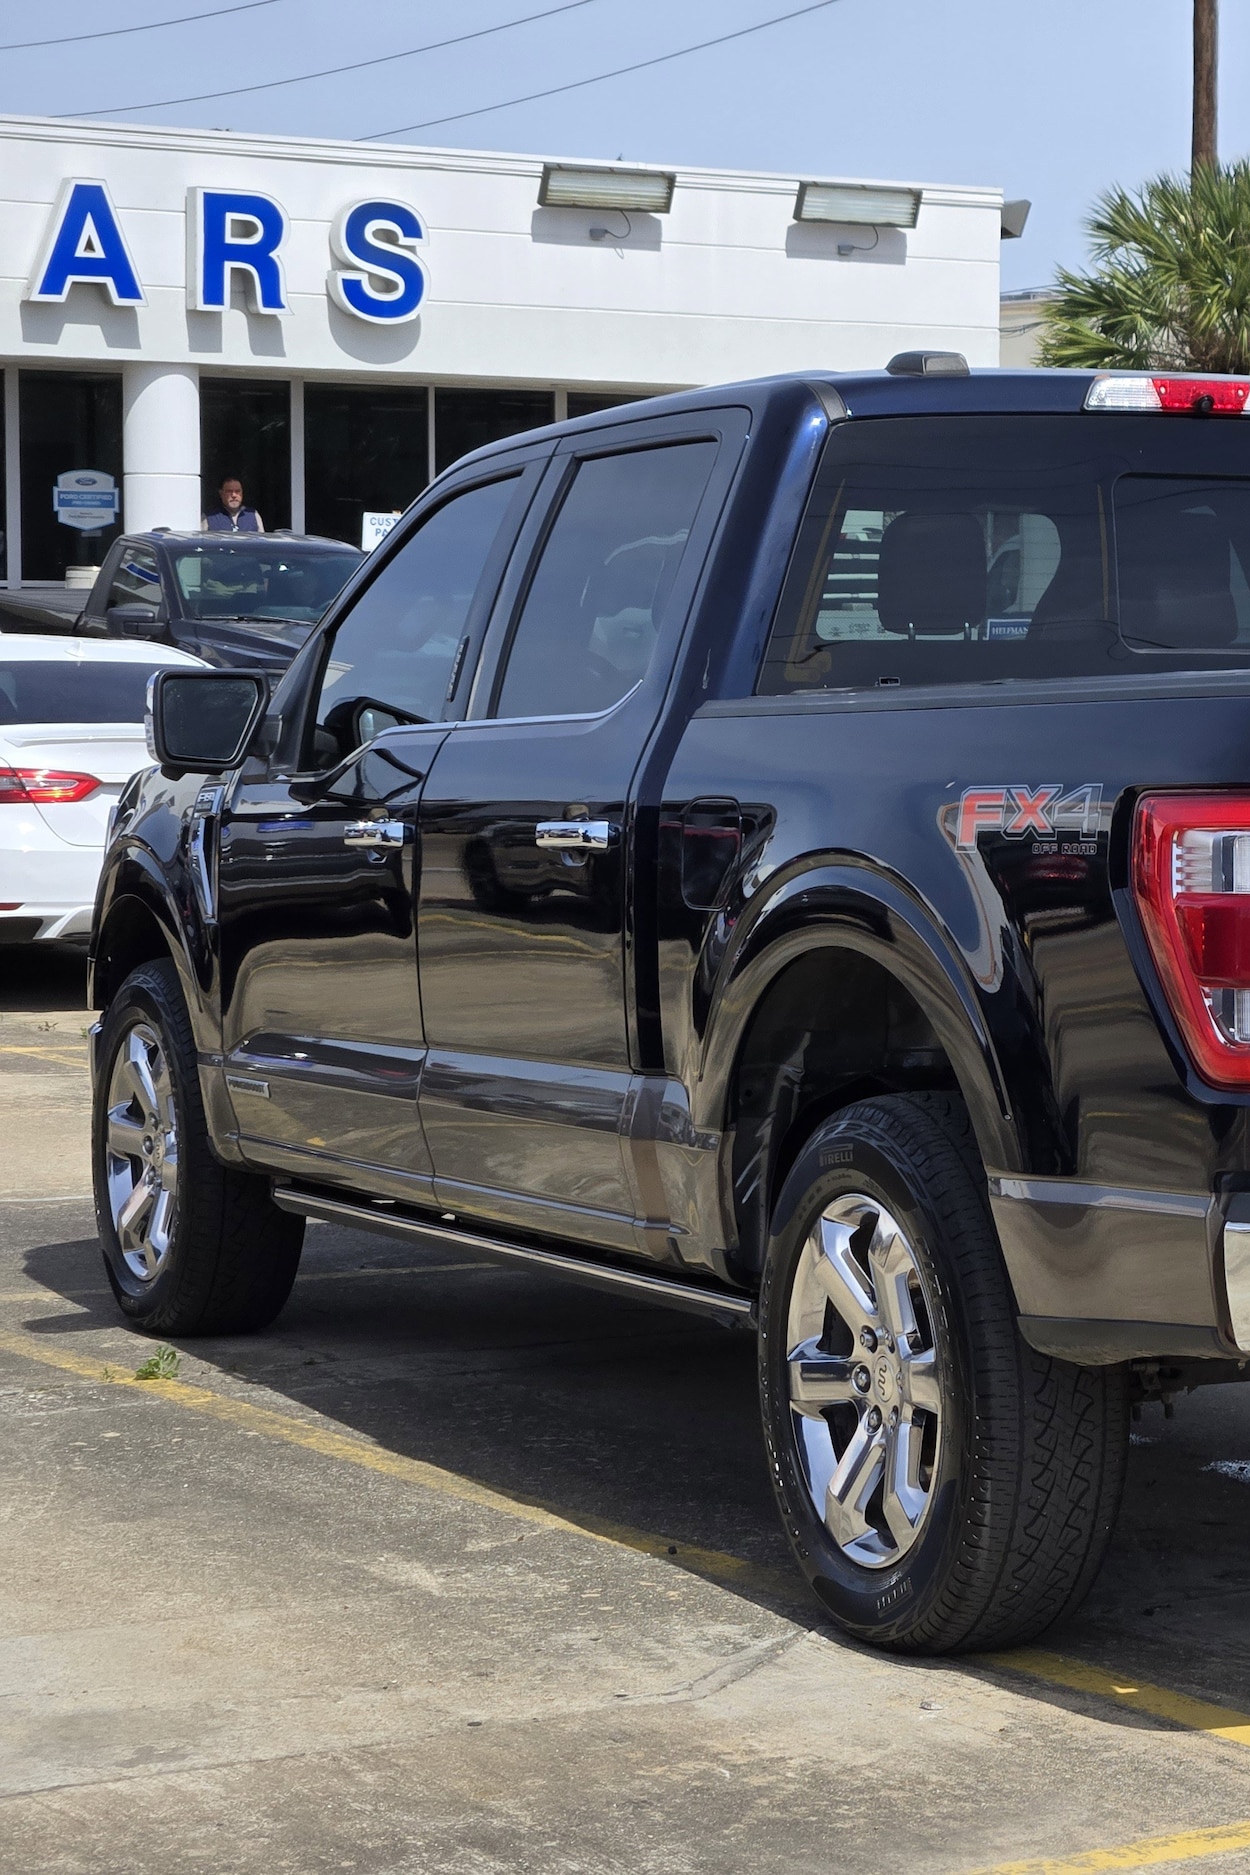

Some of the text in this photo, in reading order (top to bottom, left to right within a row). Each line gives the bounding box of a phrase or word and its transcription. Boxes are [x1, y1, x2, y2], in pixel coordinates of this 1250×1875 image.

[28, 177, 431, 325] ARS
[956, 784, 1103, 853] FX4
[1032, 843, 1098, 855] OFF ROAD
[820, 1144, 854, 1167] PIRELLI
